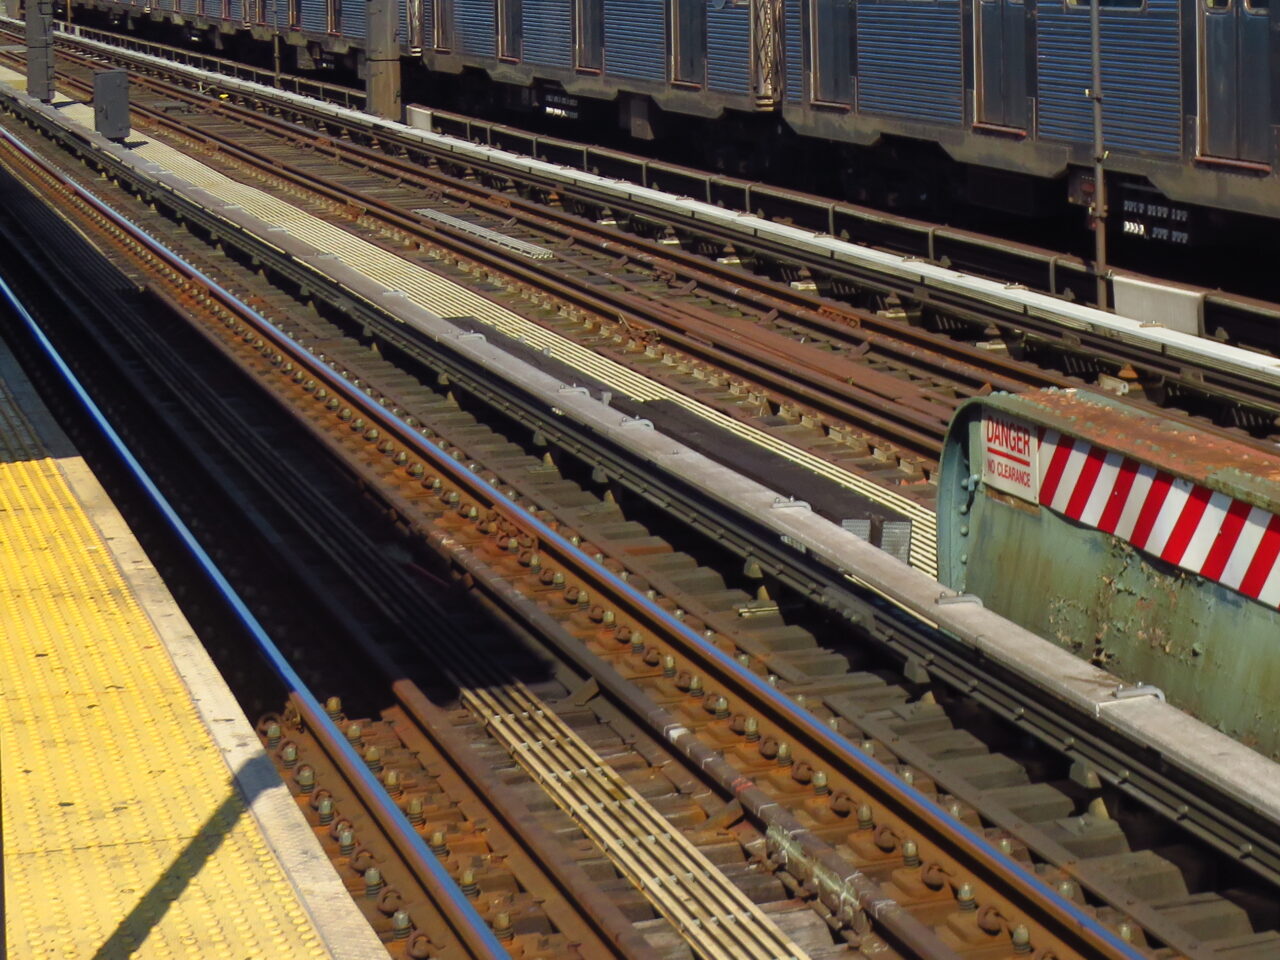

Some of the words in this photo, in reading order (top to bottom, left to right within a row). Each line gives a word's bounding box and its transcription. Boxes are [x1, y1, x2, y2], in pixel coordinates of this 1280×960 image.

[986, 416, 1031, 456] DANGER
[987, 458, 996, 474] NO
[997, 462, 1031, 488] CLEARANCE
